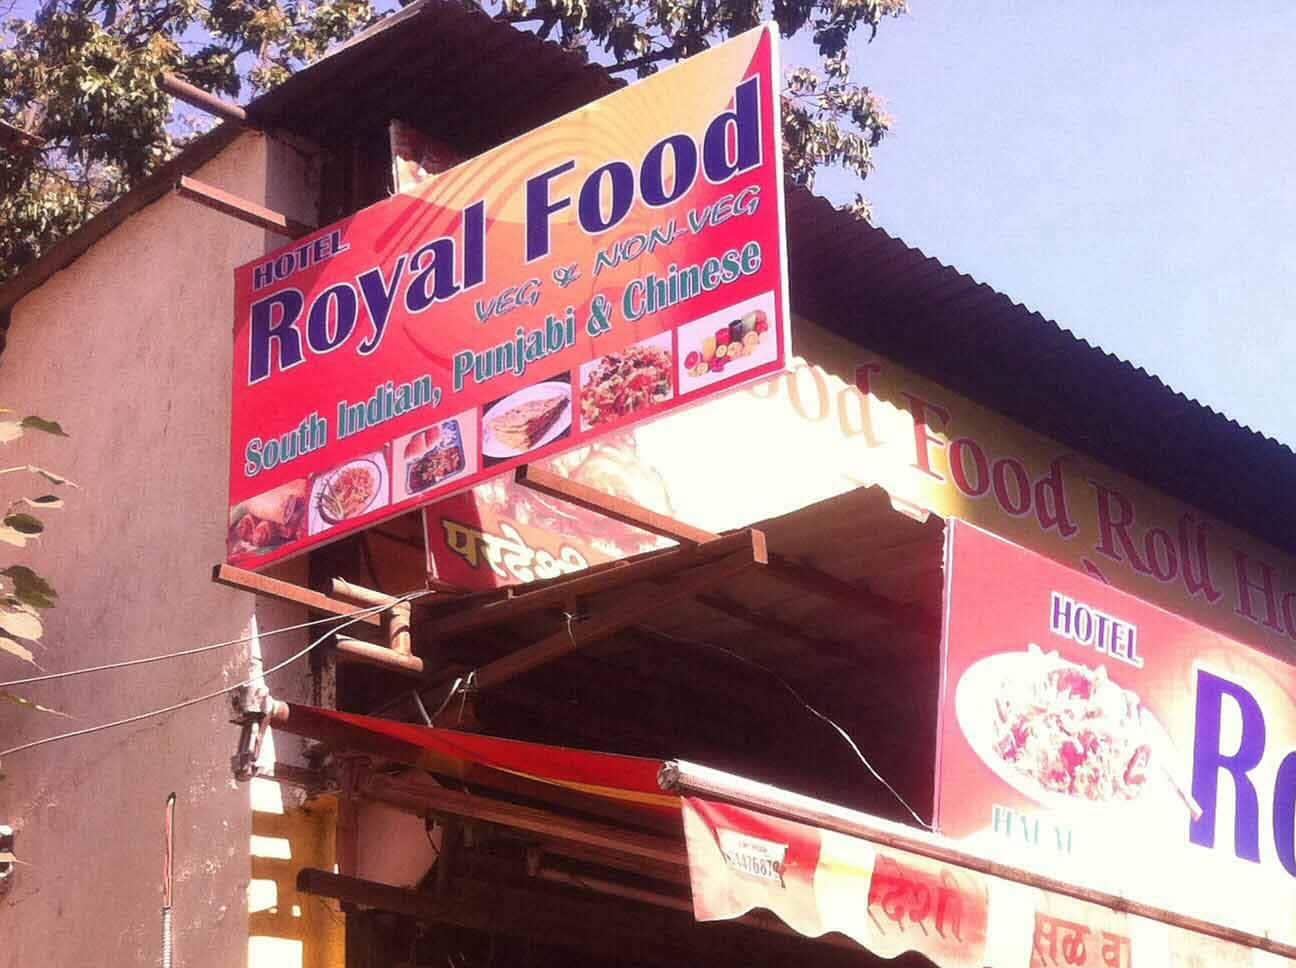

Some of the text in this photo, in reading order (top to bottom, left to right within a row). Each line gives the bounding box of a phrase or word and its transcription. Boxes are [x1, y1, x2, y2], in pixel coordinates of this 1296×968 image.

[248, 73, 763, 386] Royal Food
[250, 229, 350, 291] HOTEL
[474, 276, 542, 322] VEG
[593, 185, 762, 276] NON-VEG
[244, 240, 762, 478] South Indian, Punjabi & Chinese
[901, 390, 1078, 541] Food
[1088, 479, 1224, 605] Roll
[1051, 591, 1144, 669] HOTEL
